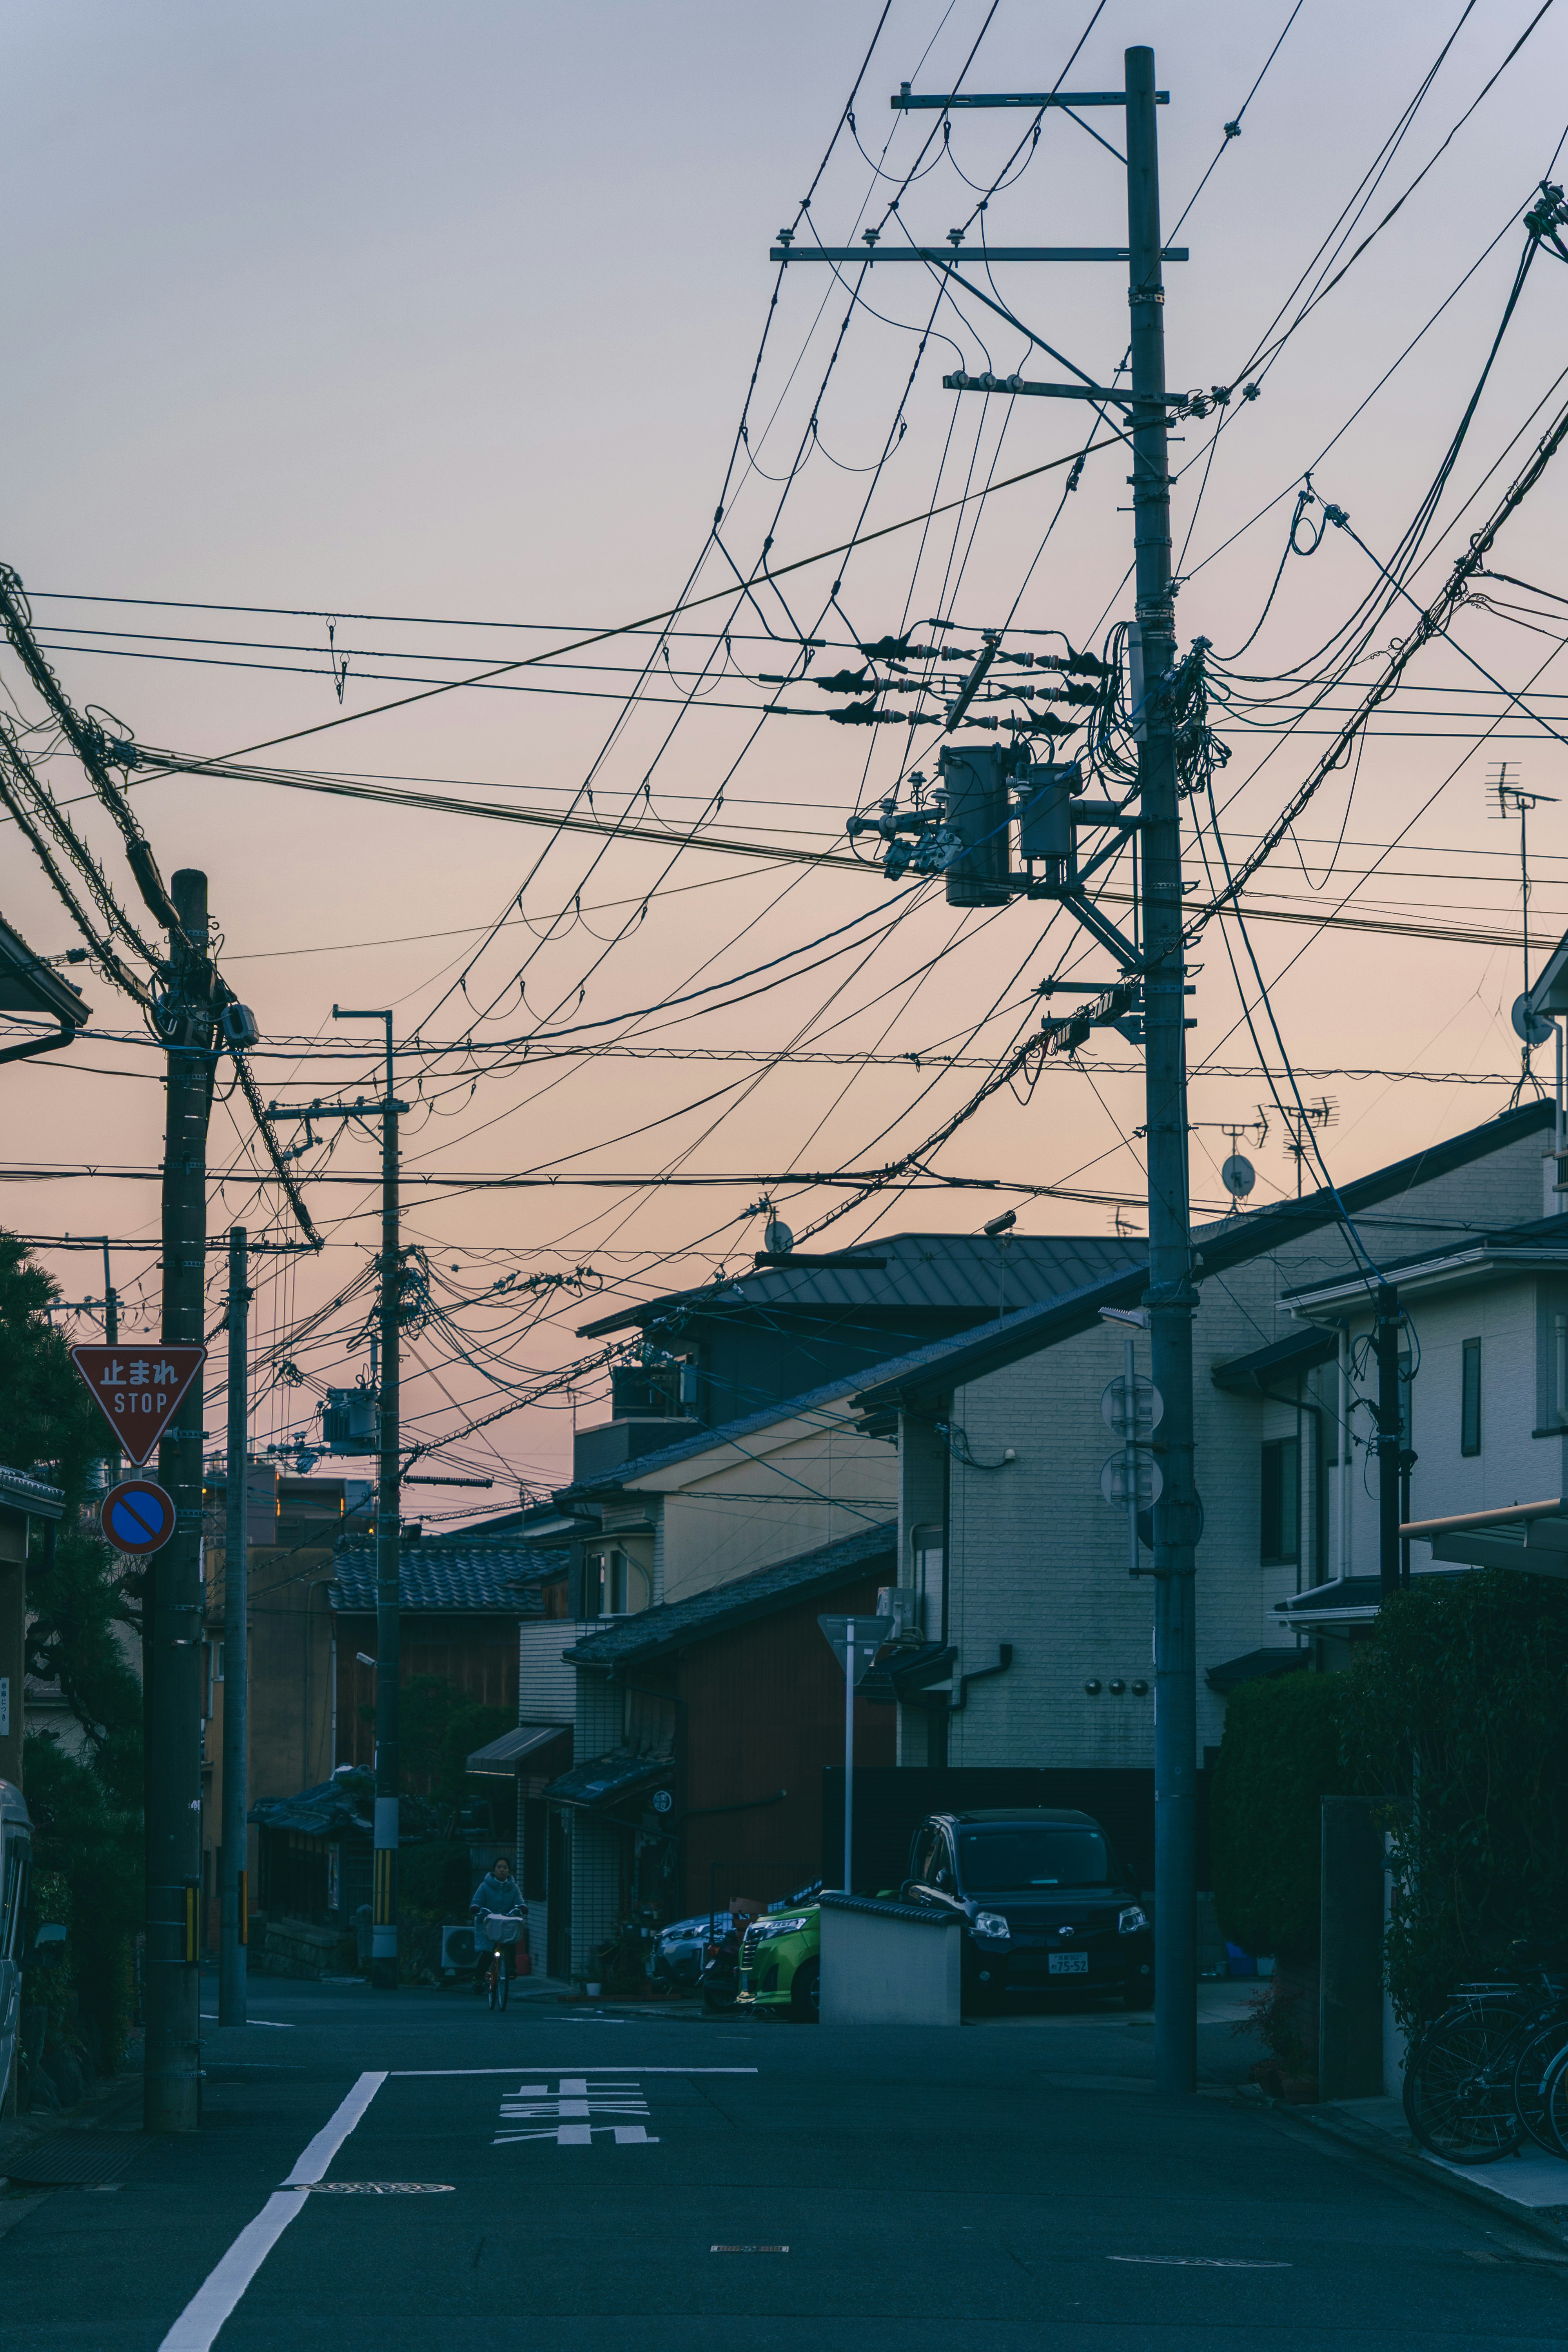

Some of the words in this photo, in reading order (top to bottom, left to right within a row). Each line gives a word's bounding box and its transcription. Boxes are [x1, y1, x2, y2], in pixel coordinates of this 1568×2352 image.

[100, 1359, 178, 1385] 止まれ
[114, 1393, 167, 1413] STOP
[1057, 1961, 1086, 1972] 75-52
[490, 2079, 659, 2145] 止まれ
